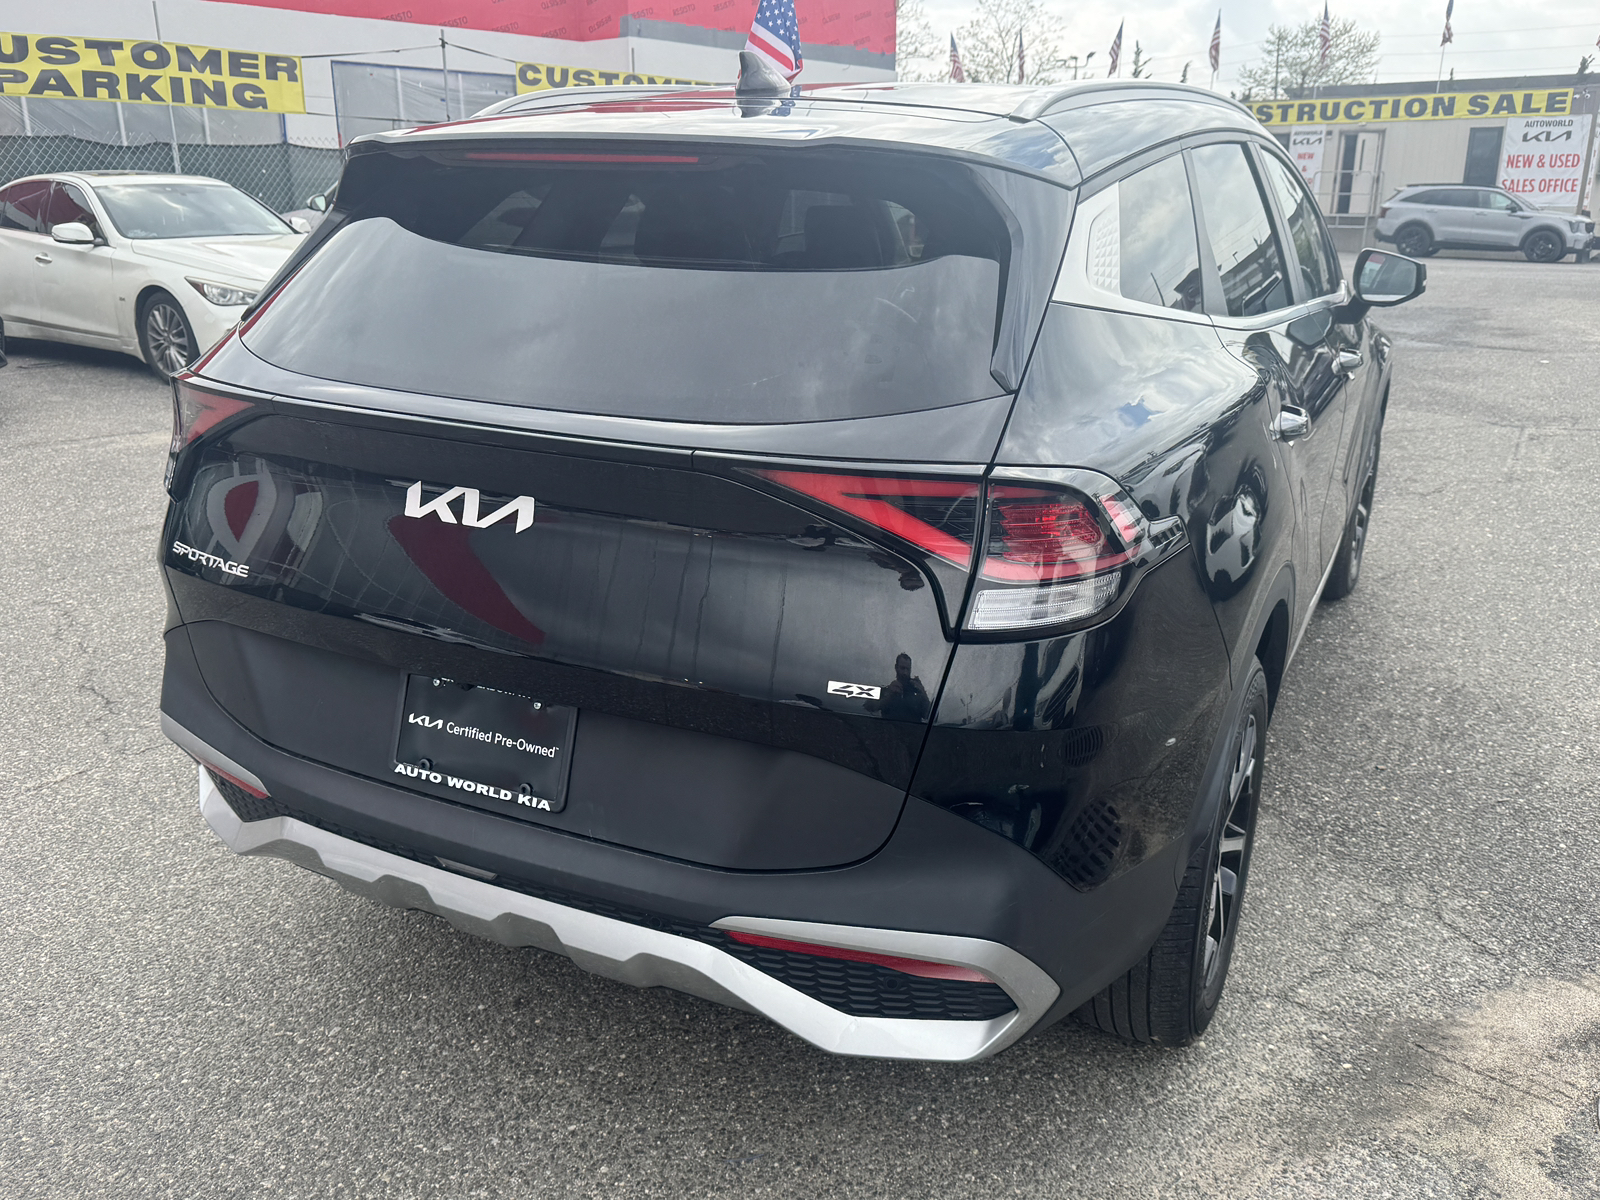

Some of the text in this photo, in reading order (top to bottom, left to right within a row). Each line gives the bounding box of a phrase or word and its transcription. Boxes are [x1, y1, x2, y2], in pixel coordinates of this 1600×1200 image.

[0, 68, 269, 110] PARKING
[518, 63, 715, 88] CUSTO
[1250, 91, 1569, 124] STRUCTION SALE
[1522, 130, 1573, 143] KIA
[1524, 119, 1574, 129] AUTOWORLD
[1292, 137, 1322, 146] KIA
[1506, 153, 1581, 169] NEW & USED
[1501, 178, 1579, 193] SALES OFFICE
[405, 480, 535, 533] KIA
[173, 541, 249, 577] SPORTAGE
[408, 712, 444, 730] KIA
[446, 721, 493, 742] Certified
[394, 763, 551, 812] AUTO WORLD KIA
